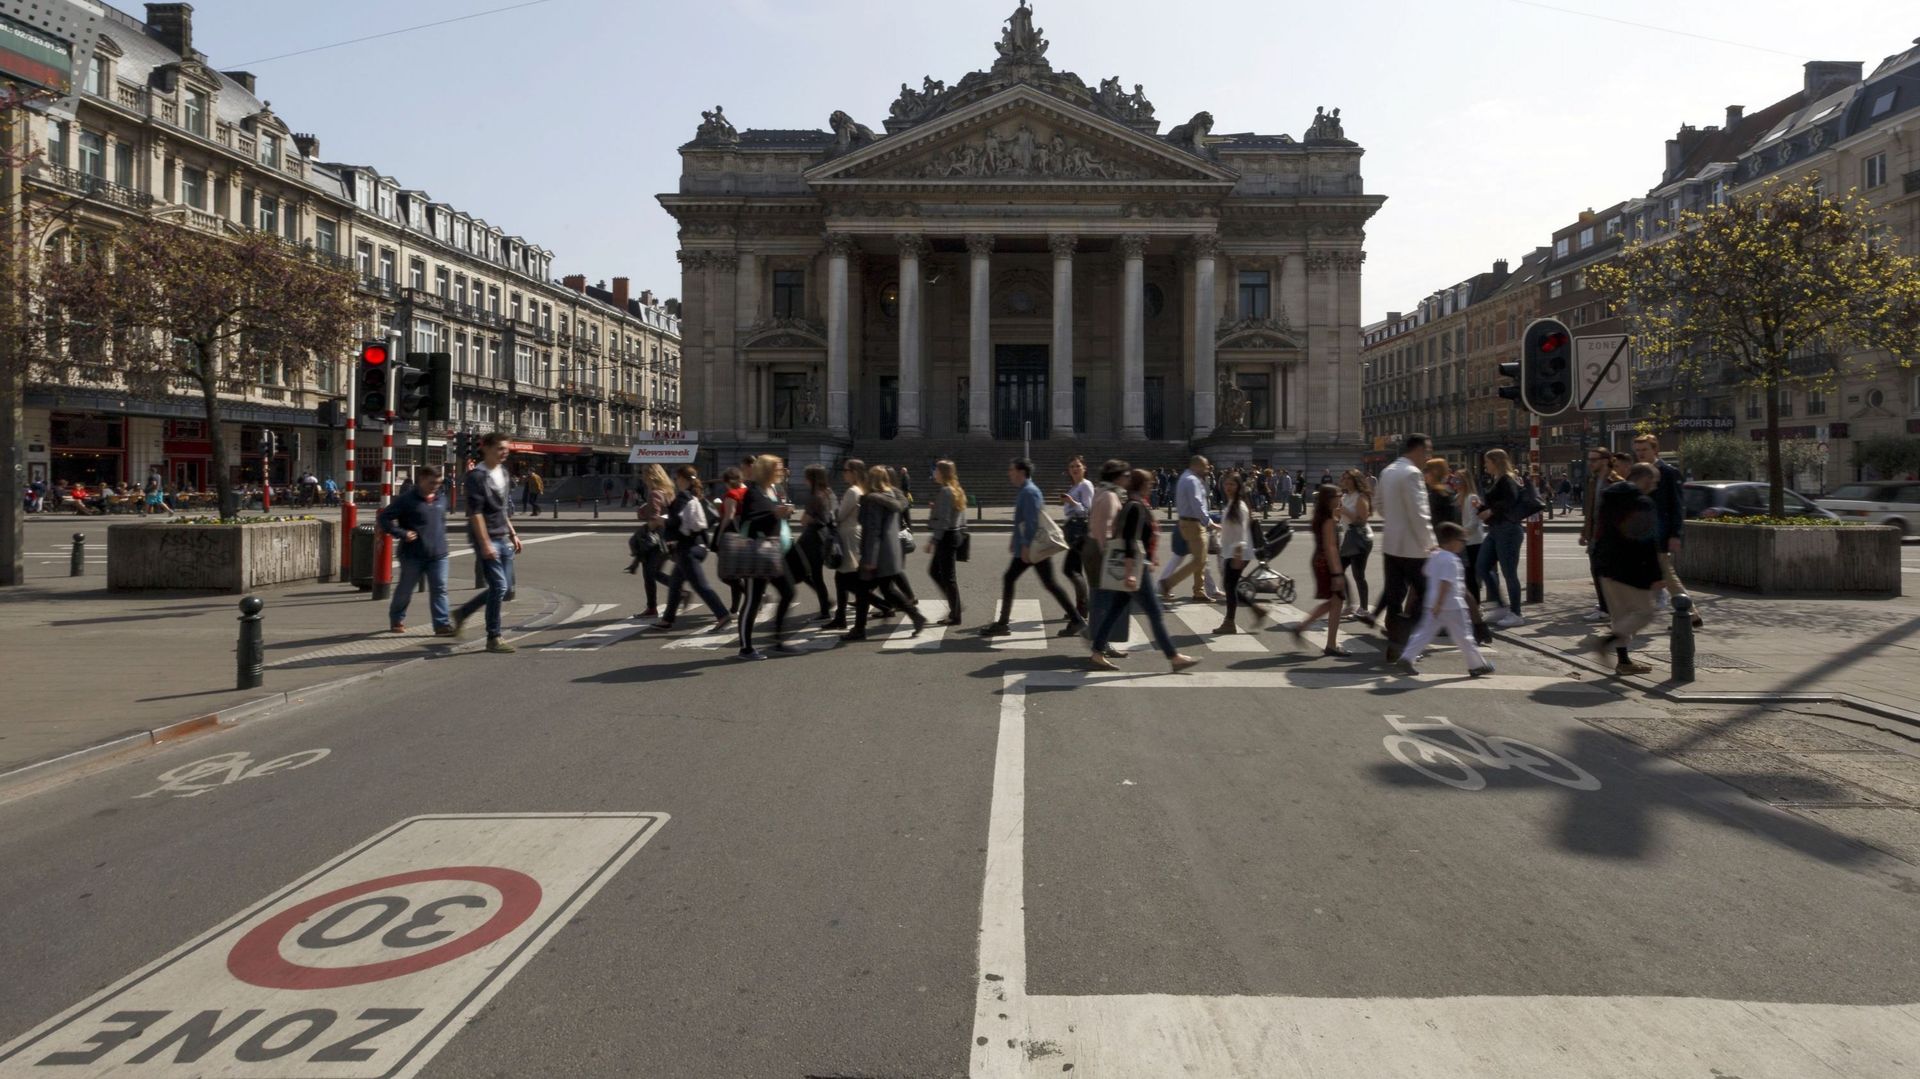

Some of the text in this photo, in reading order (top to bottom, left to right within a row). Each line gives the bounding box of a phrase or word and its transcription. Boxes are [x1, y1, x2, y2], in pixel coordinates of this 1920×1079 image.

[1588, 341, 1617, 350] ZONE
[1586, 362, 1622, 385] 30
[1678, 418, 1734, 428] SPORTS BAR
[637, 448, 690, 457] Newsweek
[297, 895, 488, 949] 30
[33, 1008, 424, 1066] ZONE
